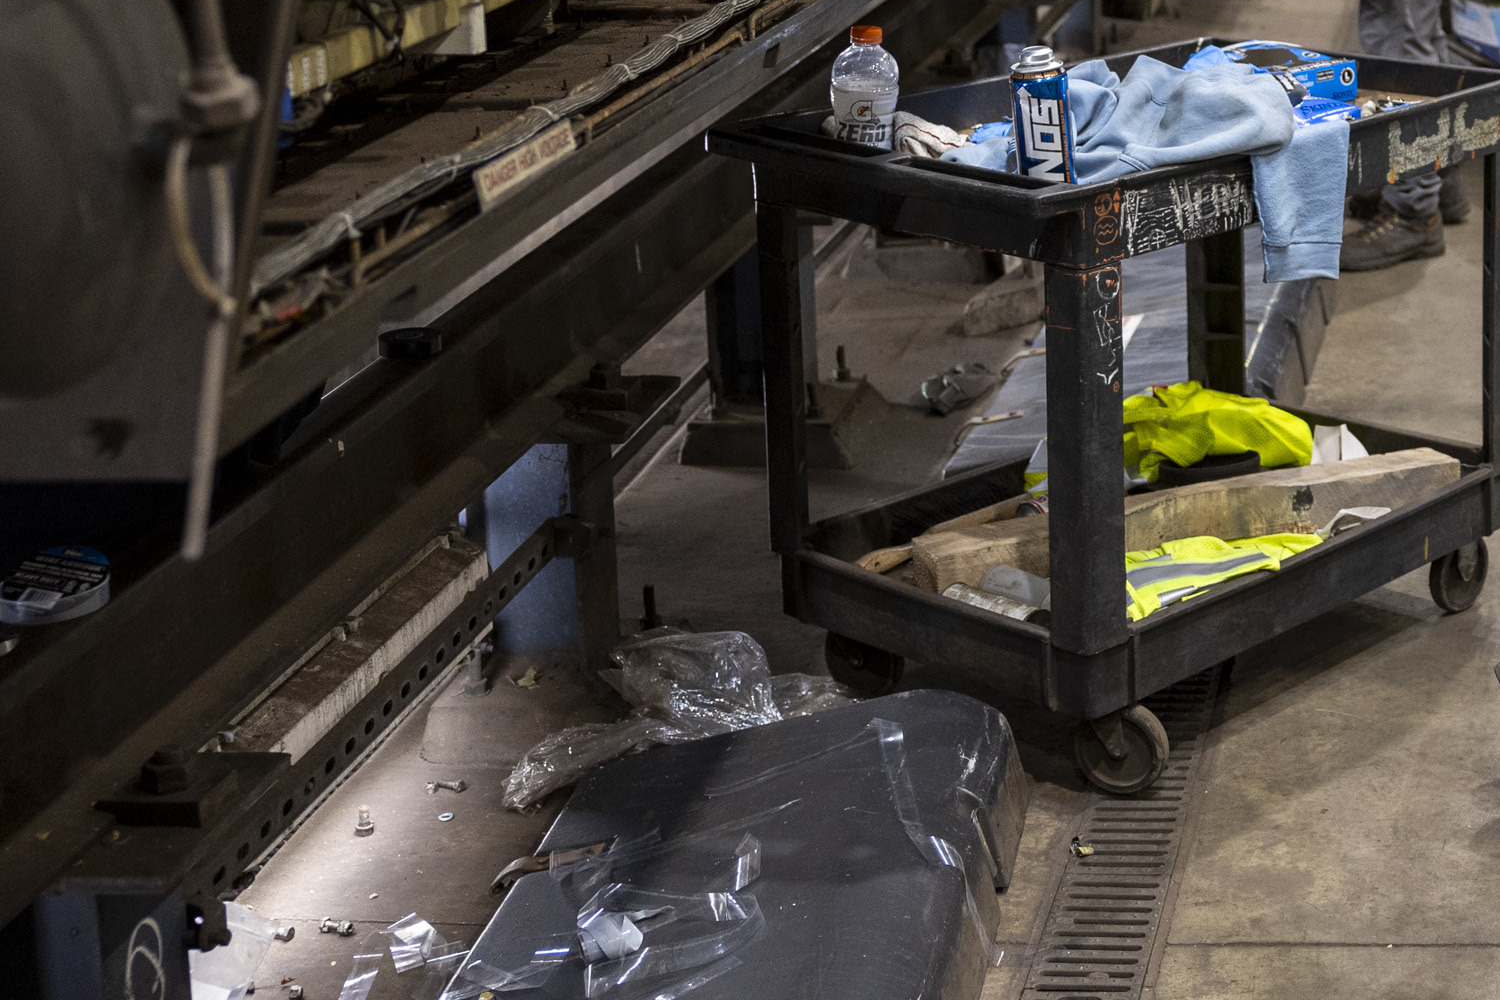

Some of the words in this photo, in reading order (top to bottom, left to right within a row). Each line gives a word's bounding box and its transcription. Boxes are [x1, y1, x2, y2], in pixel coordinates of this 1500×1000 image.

[850, 100, 873, 122] G
[837, 122, 887, 143] ZERO
[1020, 95, 1065, 182] NOS
[483, 159, 518, 192] DANGER
[519, 147, 538, 170] HIGH
